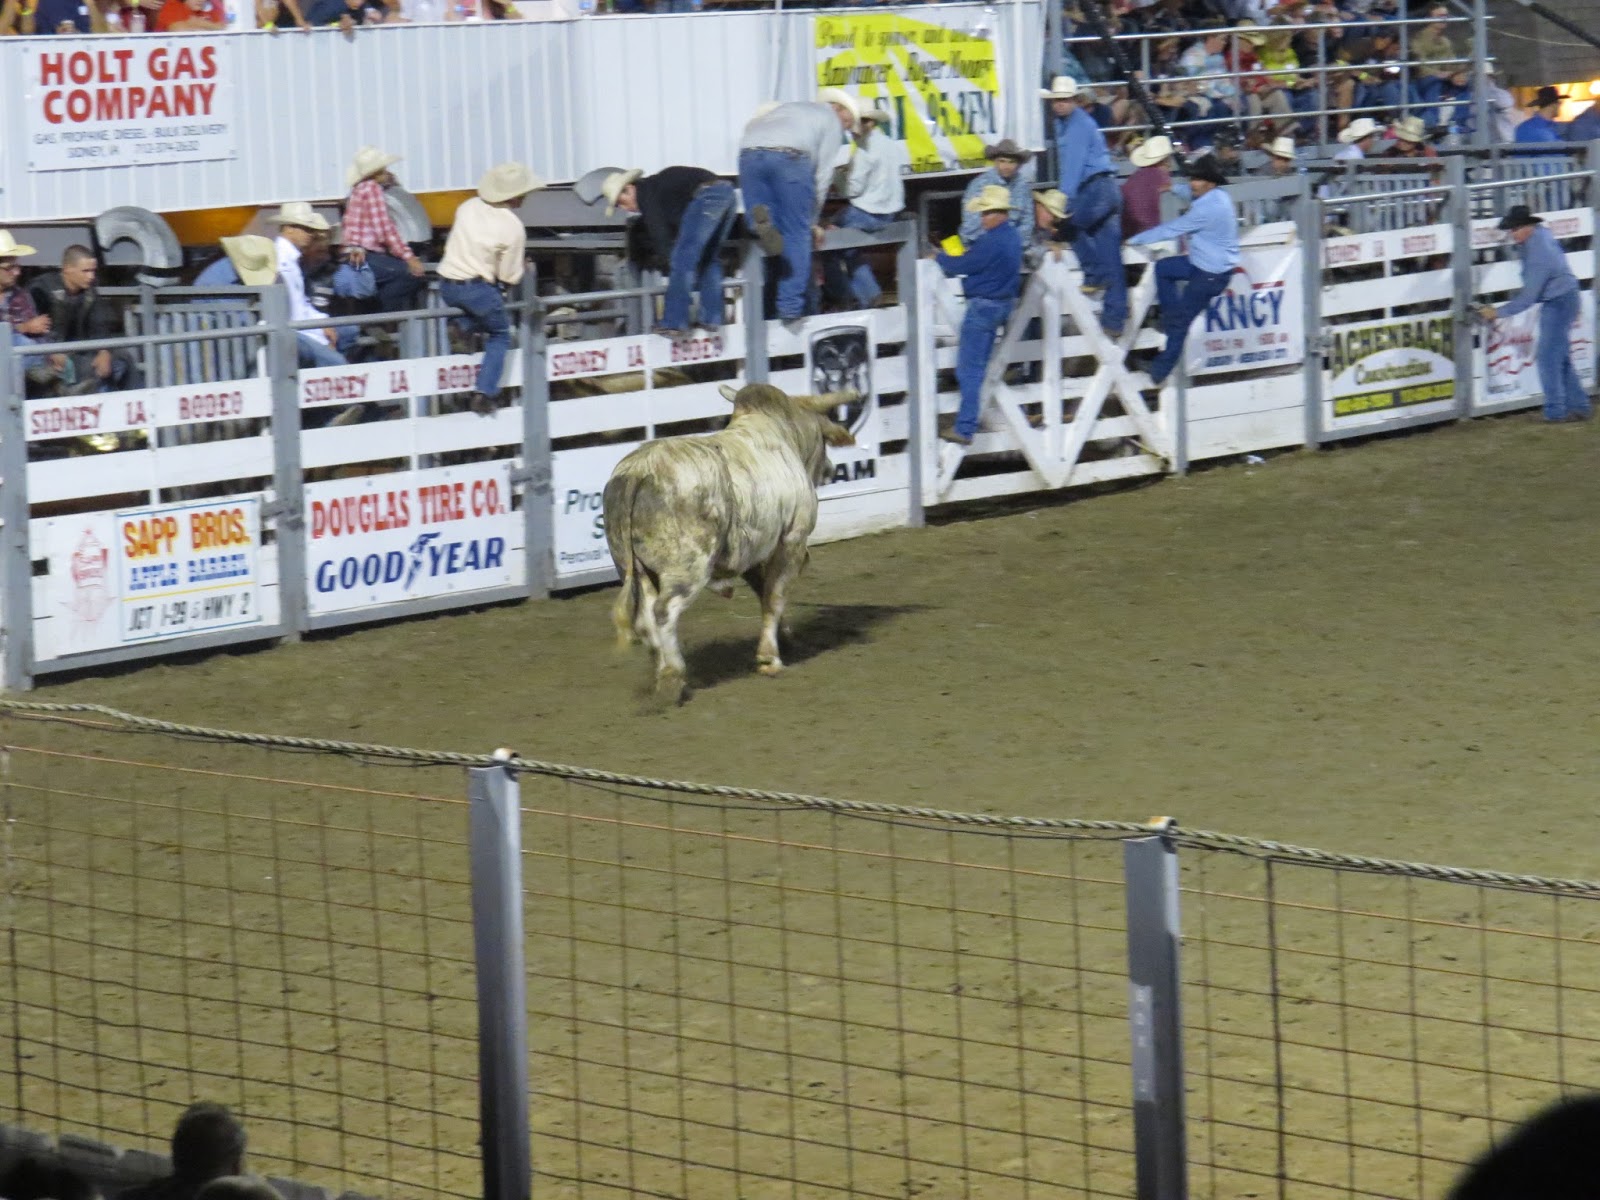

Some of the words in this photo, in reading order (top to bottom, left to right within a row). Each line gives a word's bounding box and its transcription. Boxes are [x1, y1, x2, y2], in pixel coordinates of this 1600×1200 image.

[40, 49, 134, 86] HOLT
[147, 46, 218, 81] GAS
[43, 83, 216, 124] COMPANY
[1205, 289, 1284, 333] KNCY
[304, 374, 368, 403] SIDNEY
[32, 404, 102, 434] SIDNEY
[180, 391, 243, 420] RODEO
[311, 490, 410, 539] DOUGLAS
[418, 482, 466, 525] TIRE
[470, 478, 505, 517] CO.
[124, 516, 177, 558] SAPP
[190, 508, 251, 550] BROS.
[315, 536, 505, 593] GOODYEAR
[202, 595, 234, 620] HWY
[240, 592, 249, 615] 2
